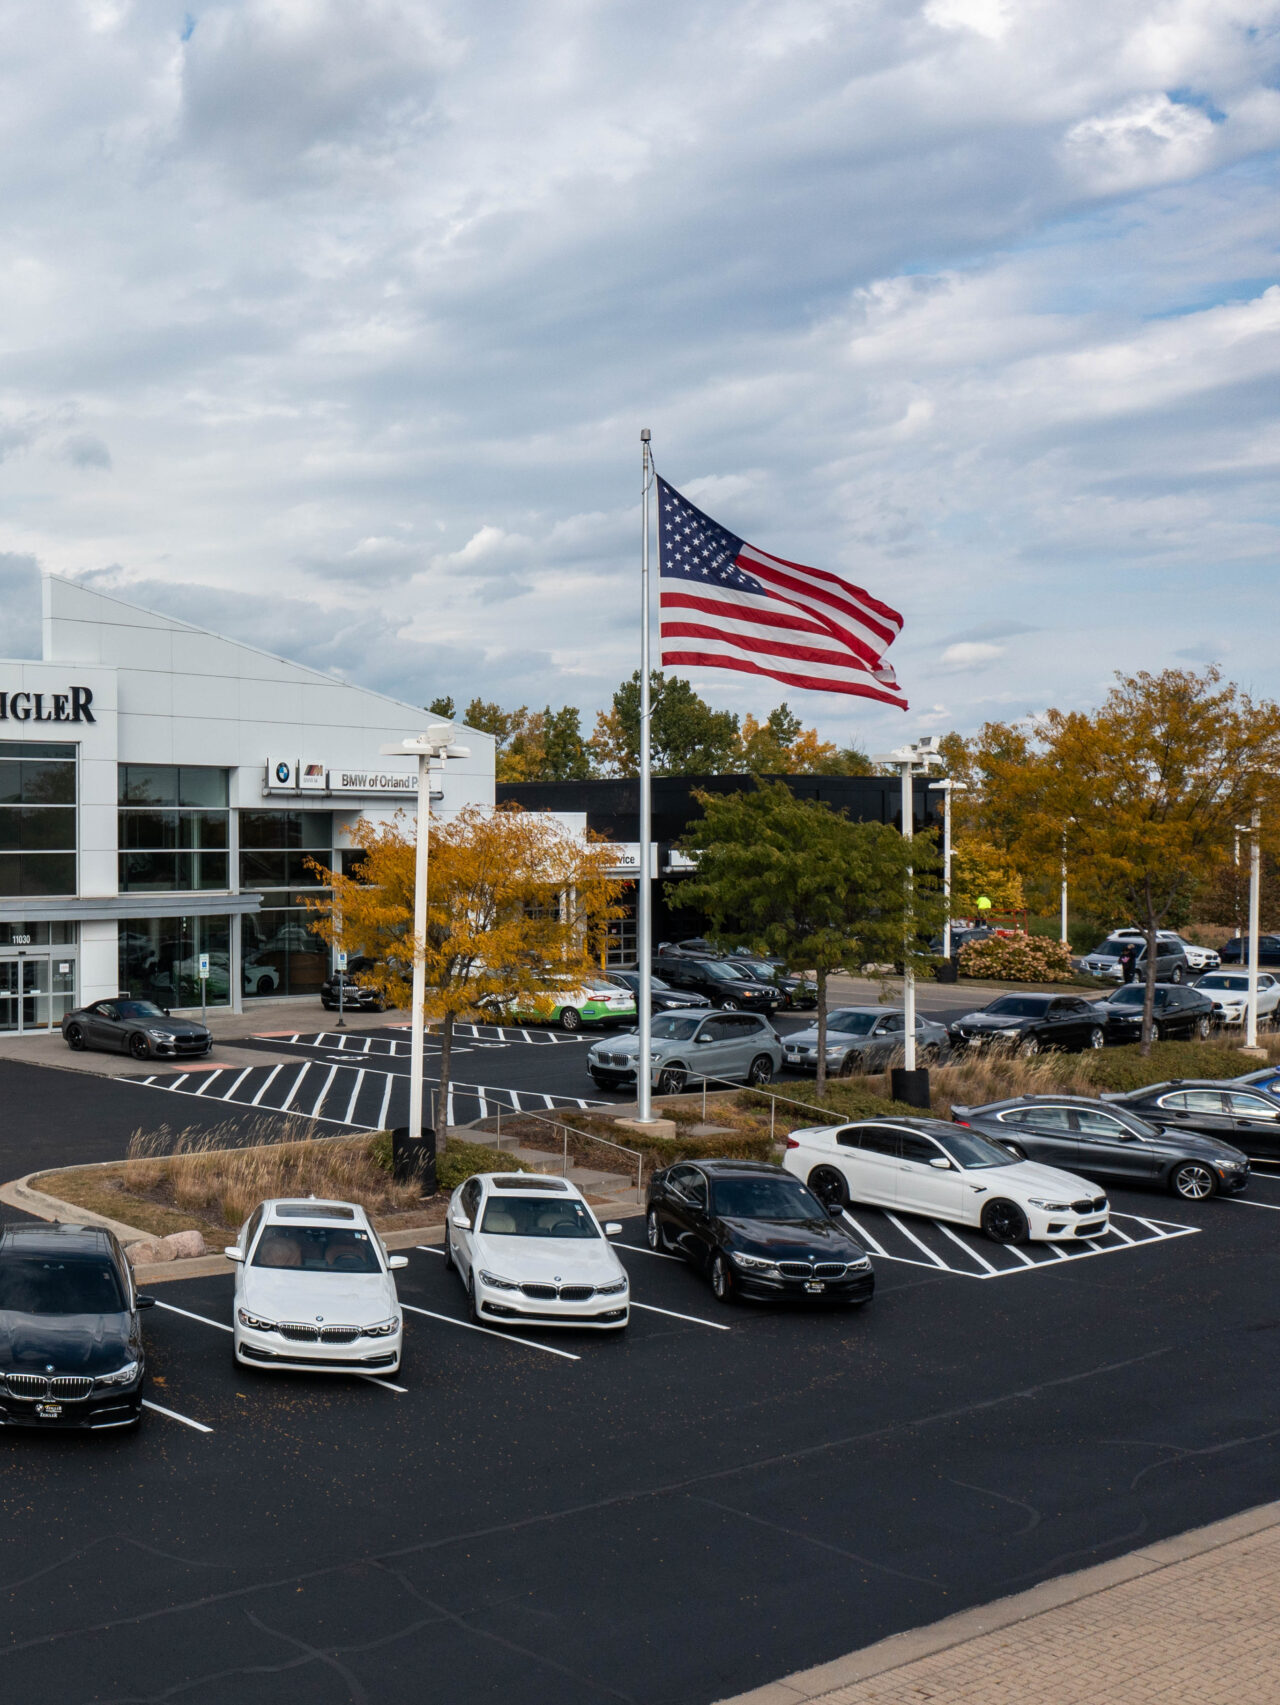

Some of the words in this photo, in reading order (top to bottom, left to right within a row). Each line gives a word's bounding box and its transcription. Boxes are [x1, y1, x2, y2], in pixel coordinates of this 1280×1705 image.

[341, 773, 368, 787] BMW
[368, 775, 379, 788] of
[379, 775, 410, 789] Orland
[12, 935, 31, 944] 11030
